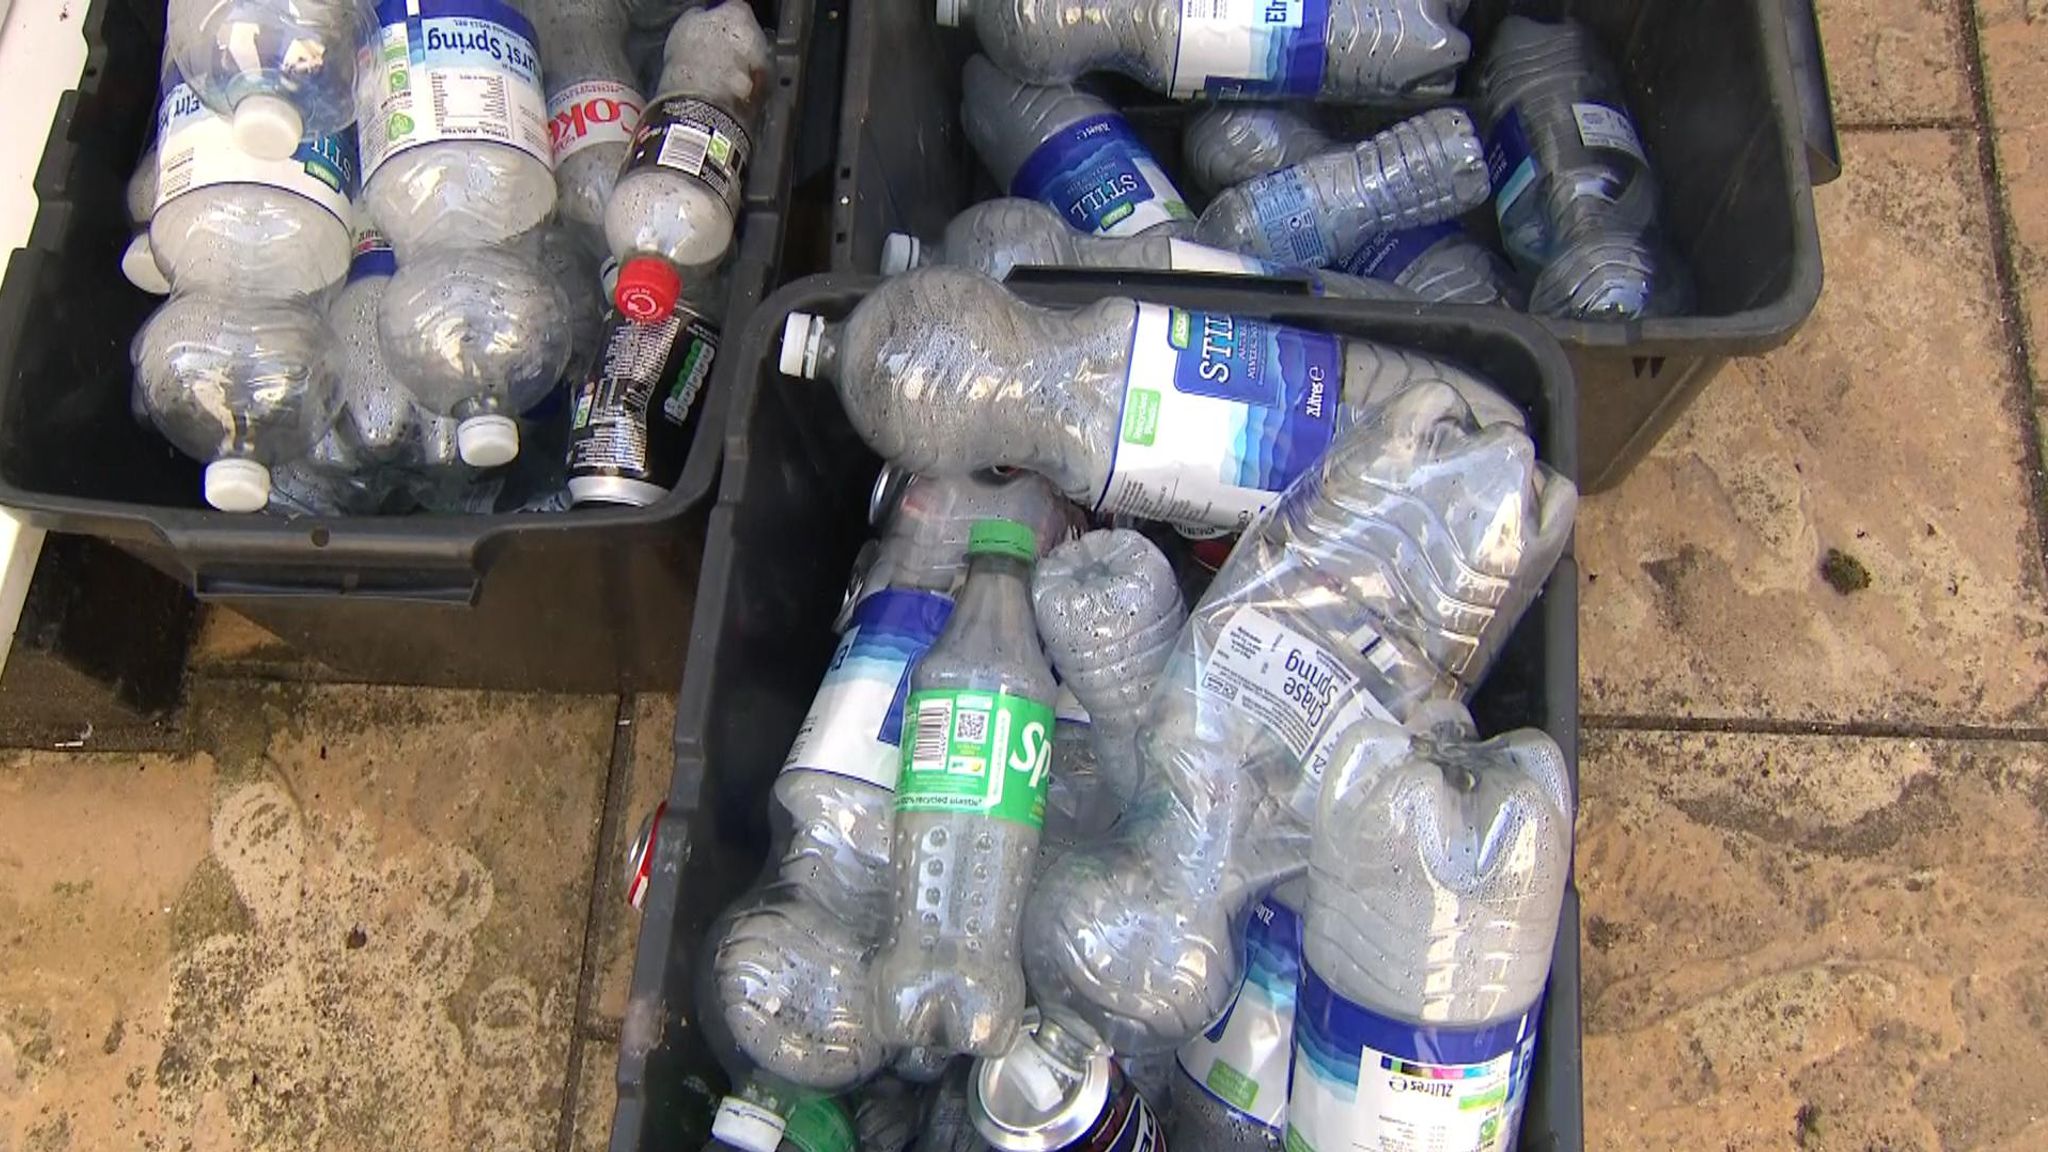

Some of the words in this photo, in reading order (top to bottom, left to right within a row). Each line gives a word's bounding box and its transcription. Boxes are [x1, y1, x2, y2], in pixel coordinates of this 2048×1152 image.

[428, 27, 501, 60] Spring
[1070, 174, 1138, 222] STILL
[1283, 676, 1324, 728] Chase
[1284, 649, 1339, 707] Spring
[1008, 721, 1052, 788] Sp
